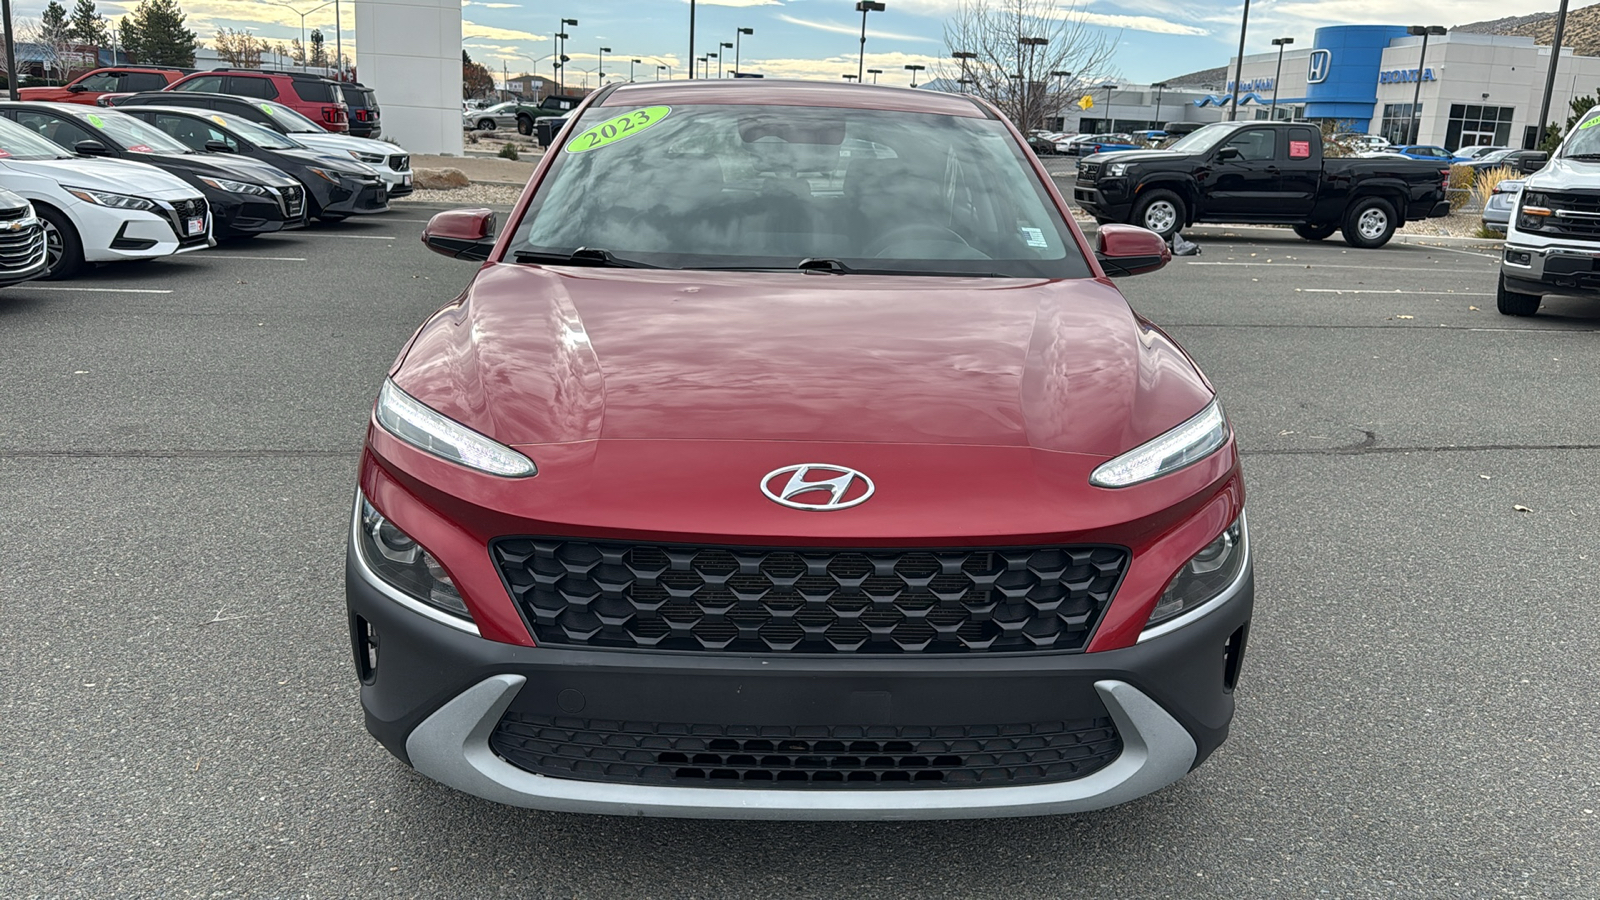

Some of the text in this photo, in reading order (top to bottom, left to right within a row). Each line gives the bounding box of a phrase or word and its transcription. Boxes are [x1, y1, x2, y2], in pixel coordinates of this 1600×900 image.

[1380, 68, 1435, 83] HONDA
[1227, 79, 1254, 92] Mhael
[583, 111, 650, 147] 2023
